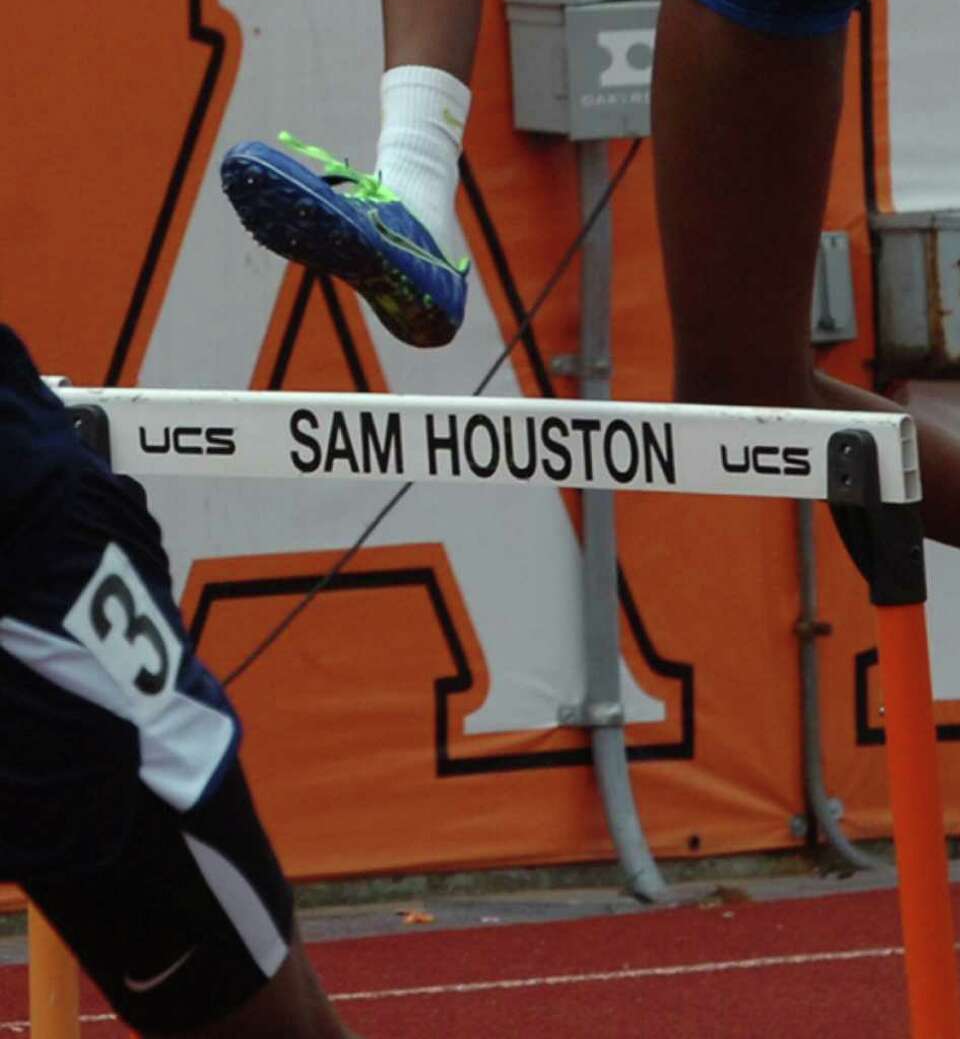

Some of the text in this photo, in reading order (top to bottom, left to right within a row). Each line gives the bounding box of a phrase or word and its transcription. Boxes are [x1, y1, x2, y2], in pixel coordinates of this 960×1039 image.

[139, 426, 236, 456] UCS
[289, 408, 677, 485] SAM HOUSTON
[720, 444, 811, 477] UCS
[91, 573, 169, 695] 3
